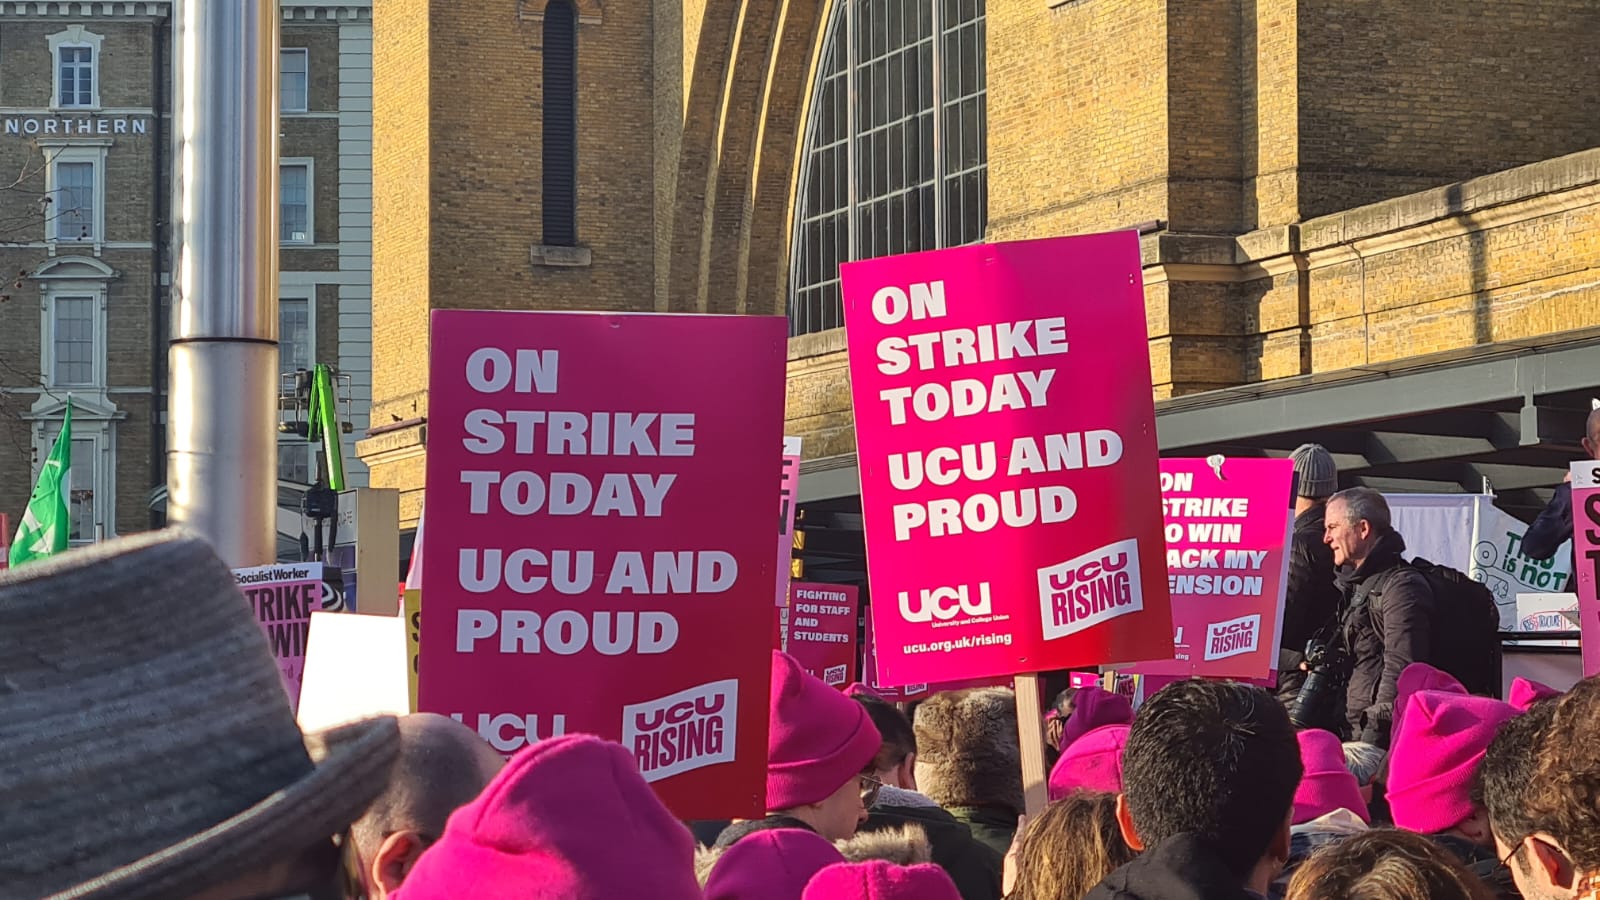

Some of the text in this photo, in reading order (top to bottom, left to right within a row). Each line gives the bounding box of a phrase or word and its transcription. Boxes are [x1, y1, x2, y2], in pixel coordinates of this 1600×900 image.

[5, 119, 146, 134] NORTHERN
[871, 280, 947, 325] ON
[876, 316, 1069, 376] STRIKE
[465, 347, 559, 393] ON
[879, 368, 1057, 426] TODAY
[462, 408, 696, 456] STRIKE
[887, 429, 1124, 490] UCU AND
[460, 470, 677, 517] TODAY
[1160, 472, 1193, 492] ON
[893, 485, 1077, 541] PROUD
[1165, 523, 1242, 543] O WIN
[235, 568, 310, 584] Socialist Worker
[458, 548, 739, 594] UCU AND
[1049, 552, 1128, 590] UCU
[1166, 549, 1269, 569] ACK MY
[244, 584, 316, 622] TRIKE
[796, 589, 847, 601] FIGHTING
[1051, 571, 1131, 626] RISING
[1168, 575, 1263, 596] ENSION
[795, 604, 851, 615] FOR STAFF
[795, 617, 819, 627] AND
[1213, 621, 1254, 636] UCU
[456, 609, 679, 655] PROUD
[794, 631, 849, 643] STUDENTS
[903, 633, 1012, 654] ucu.org.uk/rising
[1210, 630, 1253, 654] RISING
[635, 694, 725, 732] UCU
[634, 715, 723, 771] RISING
